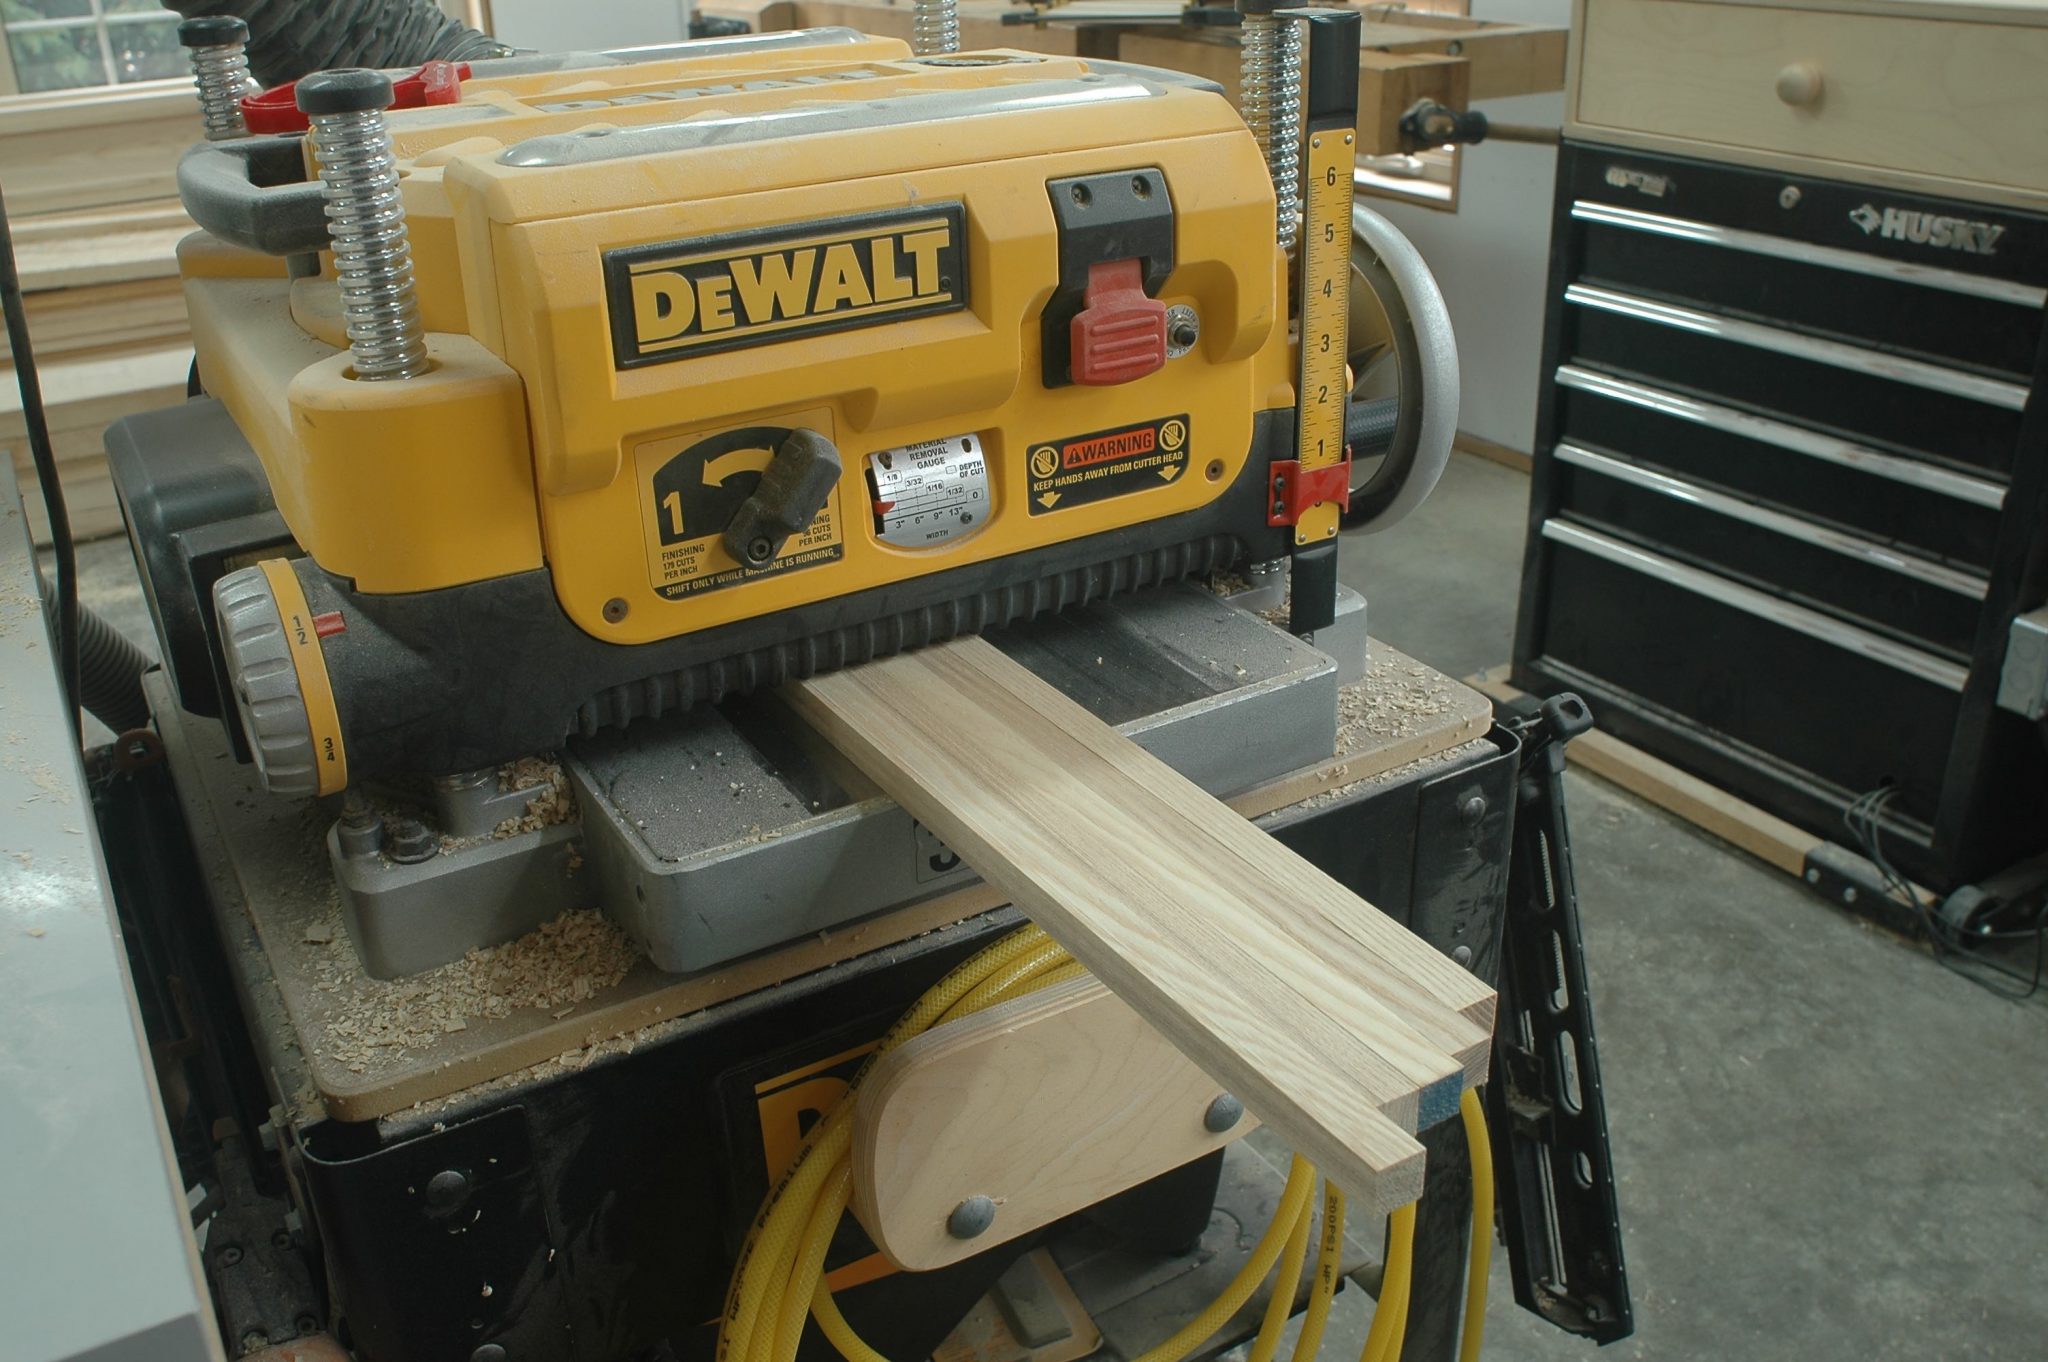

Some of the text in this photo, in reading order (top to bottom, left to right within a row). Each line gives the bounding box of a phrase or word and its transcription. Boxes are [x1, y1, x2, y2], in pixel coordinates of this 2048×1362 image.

[1326, 167, 1336, 186] 6
[1325, 224, 1334, 243] 5
[1881, 207, 2006, 255] HUSKY
[630, 228, 950, 342] DEWALT
[1323, 280, 1332, 297] 4
[1321, 334, 1330, 352] 3
[1318, 386, 1328, 404] 2
[905, 439, 947, 452] MATERIAL
[1082, 434, 1152, 461] WARNING
[1317, 439, 1324, 456] 1
[909, 447, 948, 461] REMOVAL
[917, 457, 946, 470] GAUGE
[959, 460, 983, 471] DEPTH
[970, 467, 984, 475] CUT
[1033, 451, 1184, 493] KEEP HANDS AWAY FROM CUTTER HEAD
[906, 477, 922, 487] 3/32
[927, 483, 943, 492] 1/16
[948, 486, 963, 496] 1/32
[972, 491, 979, 500] 0
[663, 490, 685, 536] 1
[812, 523, 832, 535] CUTS
[926, 529, 949, 541] WIDTH
[799, 532, 832, 547] PER INCH
[662, 543, 705, 561] FINISHING
[676, 556, 695, 567] CUTS
[664, 565, 698, 580] PER INCH
[666, 582, 690, 597] SHIFT
[692, 575, 715, 590] ONLY
[717, 569, 743, 584] WHILE
[785, 557, 794, 567] IS
[795, 548, 833, 565] RUNNING
